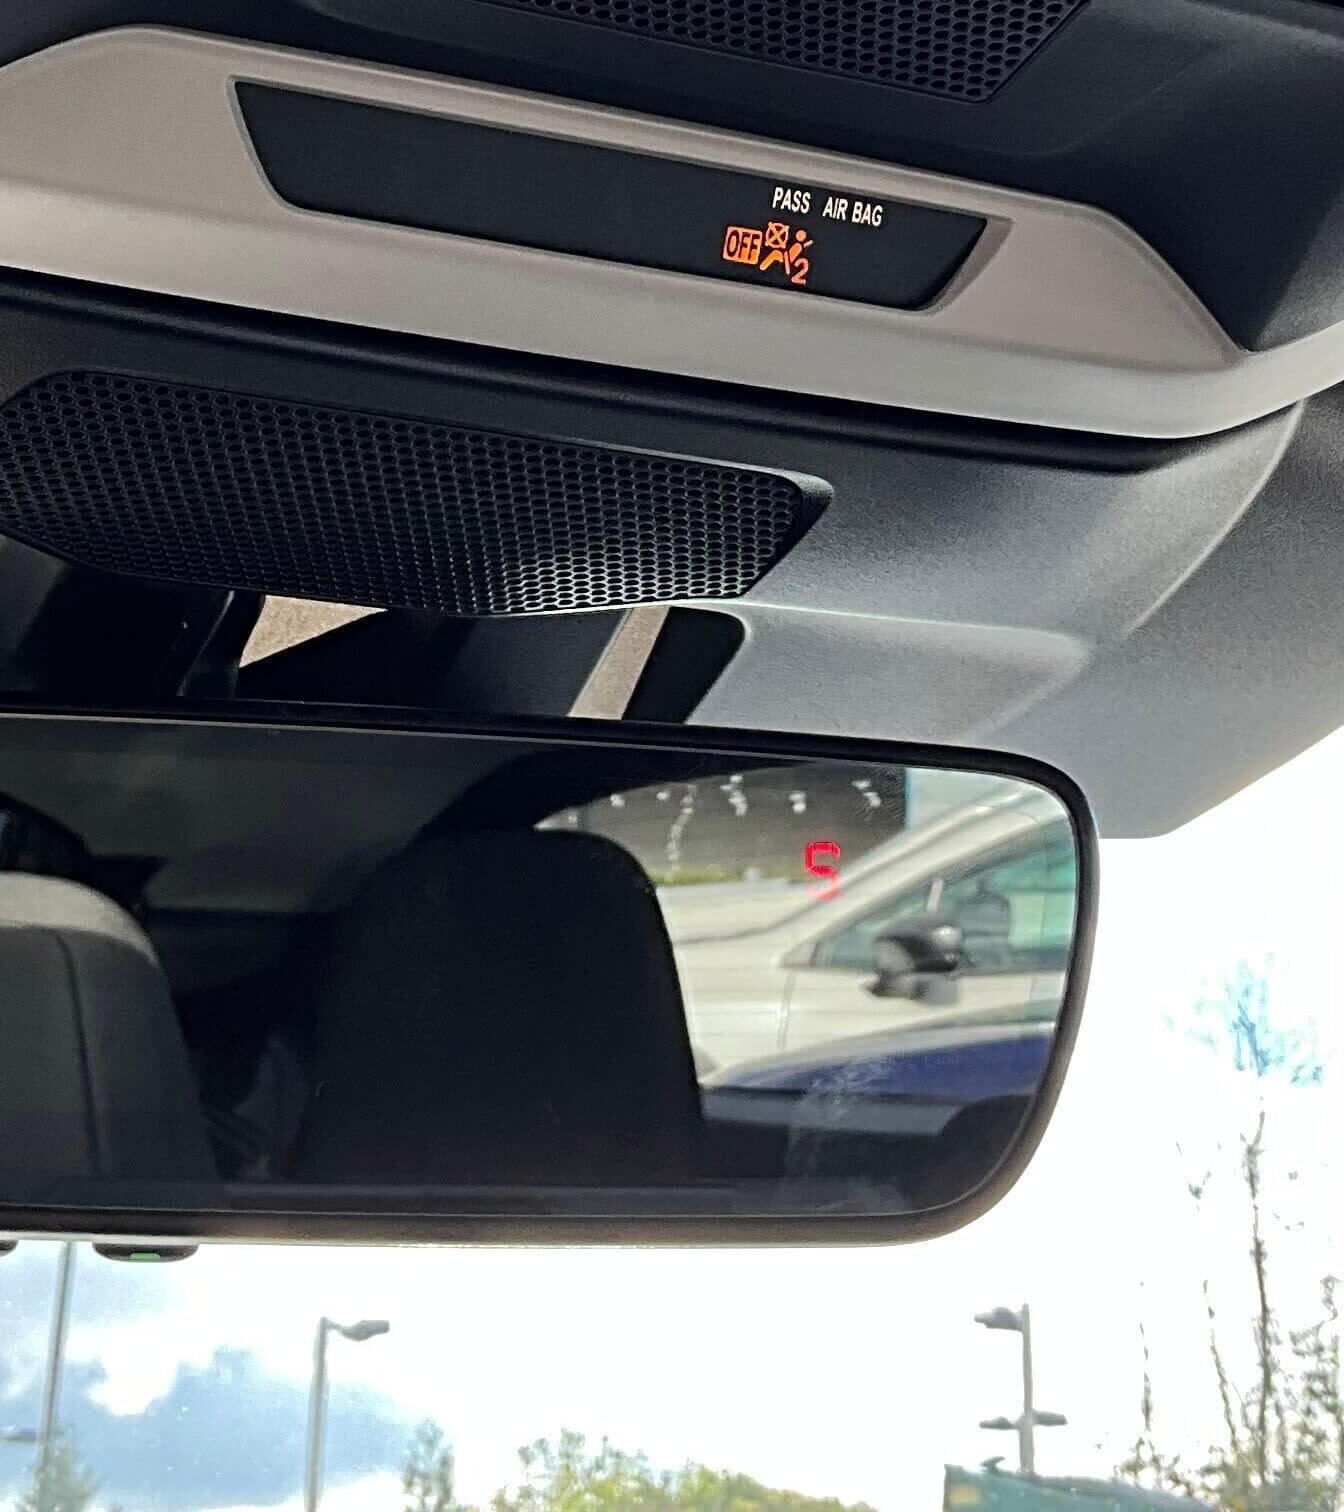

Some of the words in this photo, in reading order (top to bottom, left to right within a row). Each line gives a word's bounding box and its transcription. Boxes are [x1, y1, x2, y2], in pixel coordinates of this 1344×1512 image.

[772, 186, 812, 214] PASS
[822, 196, 848, 222] AIR
[851, 200, 884, 227] BAG
[726, 230, 761, 264] OFF
[804, 840, 842, 901] S
